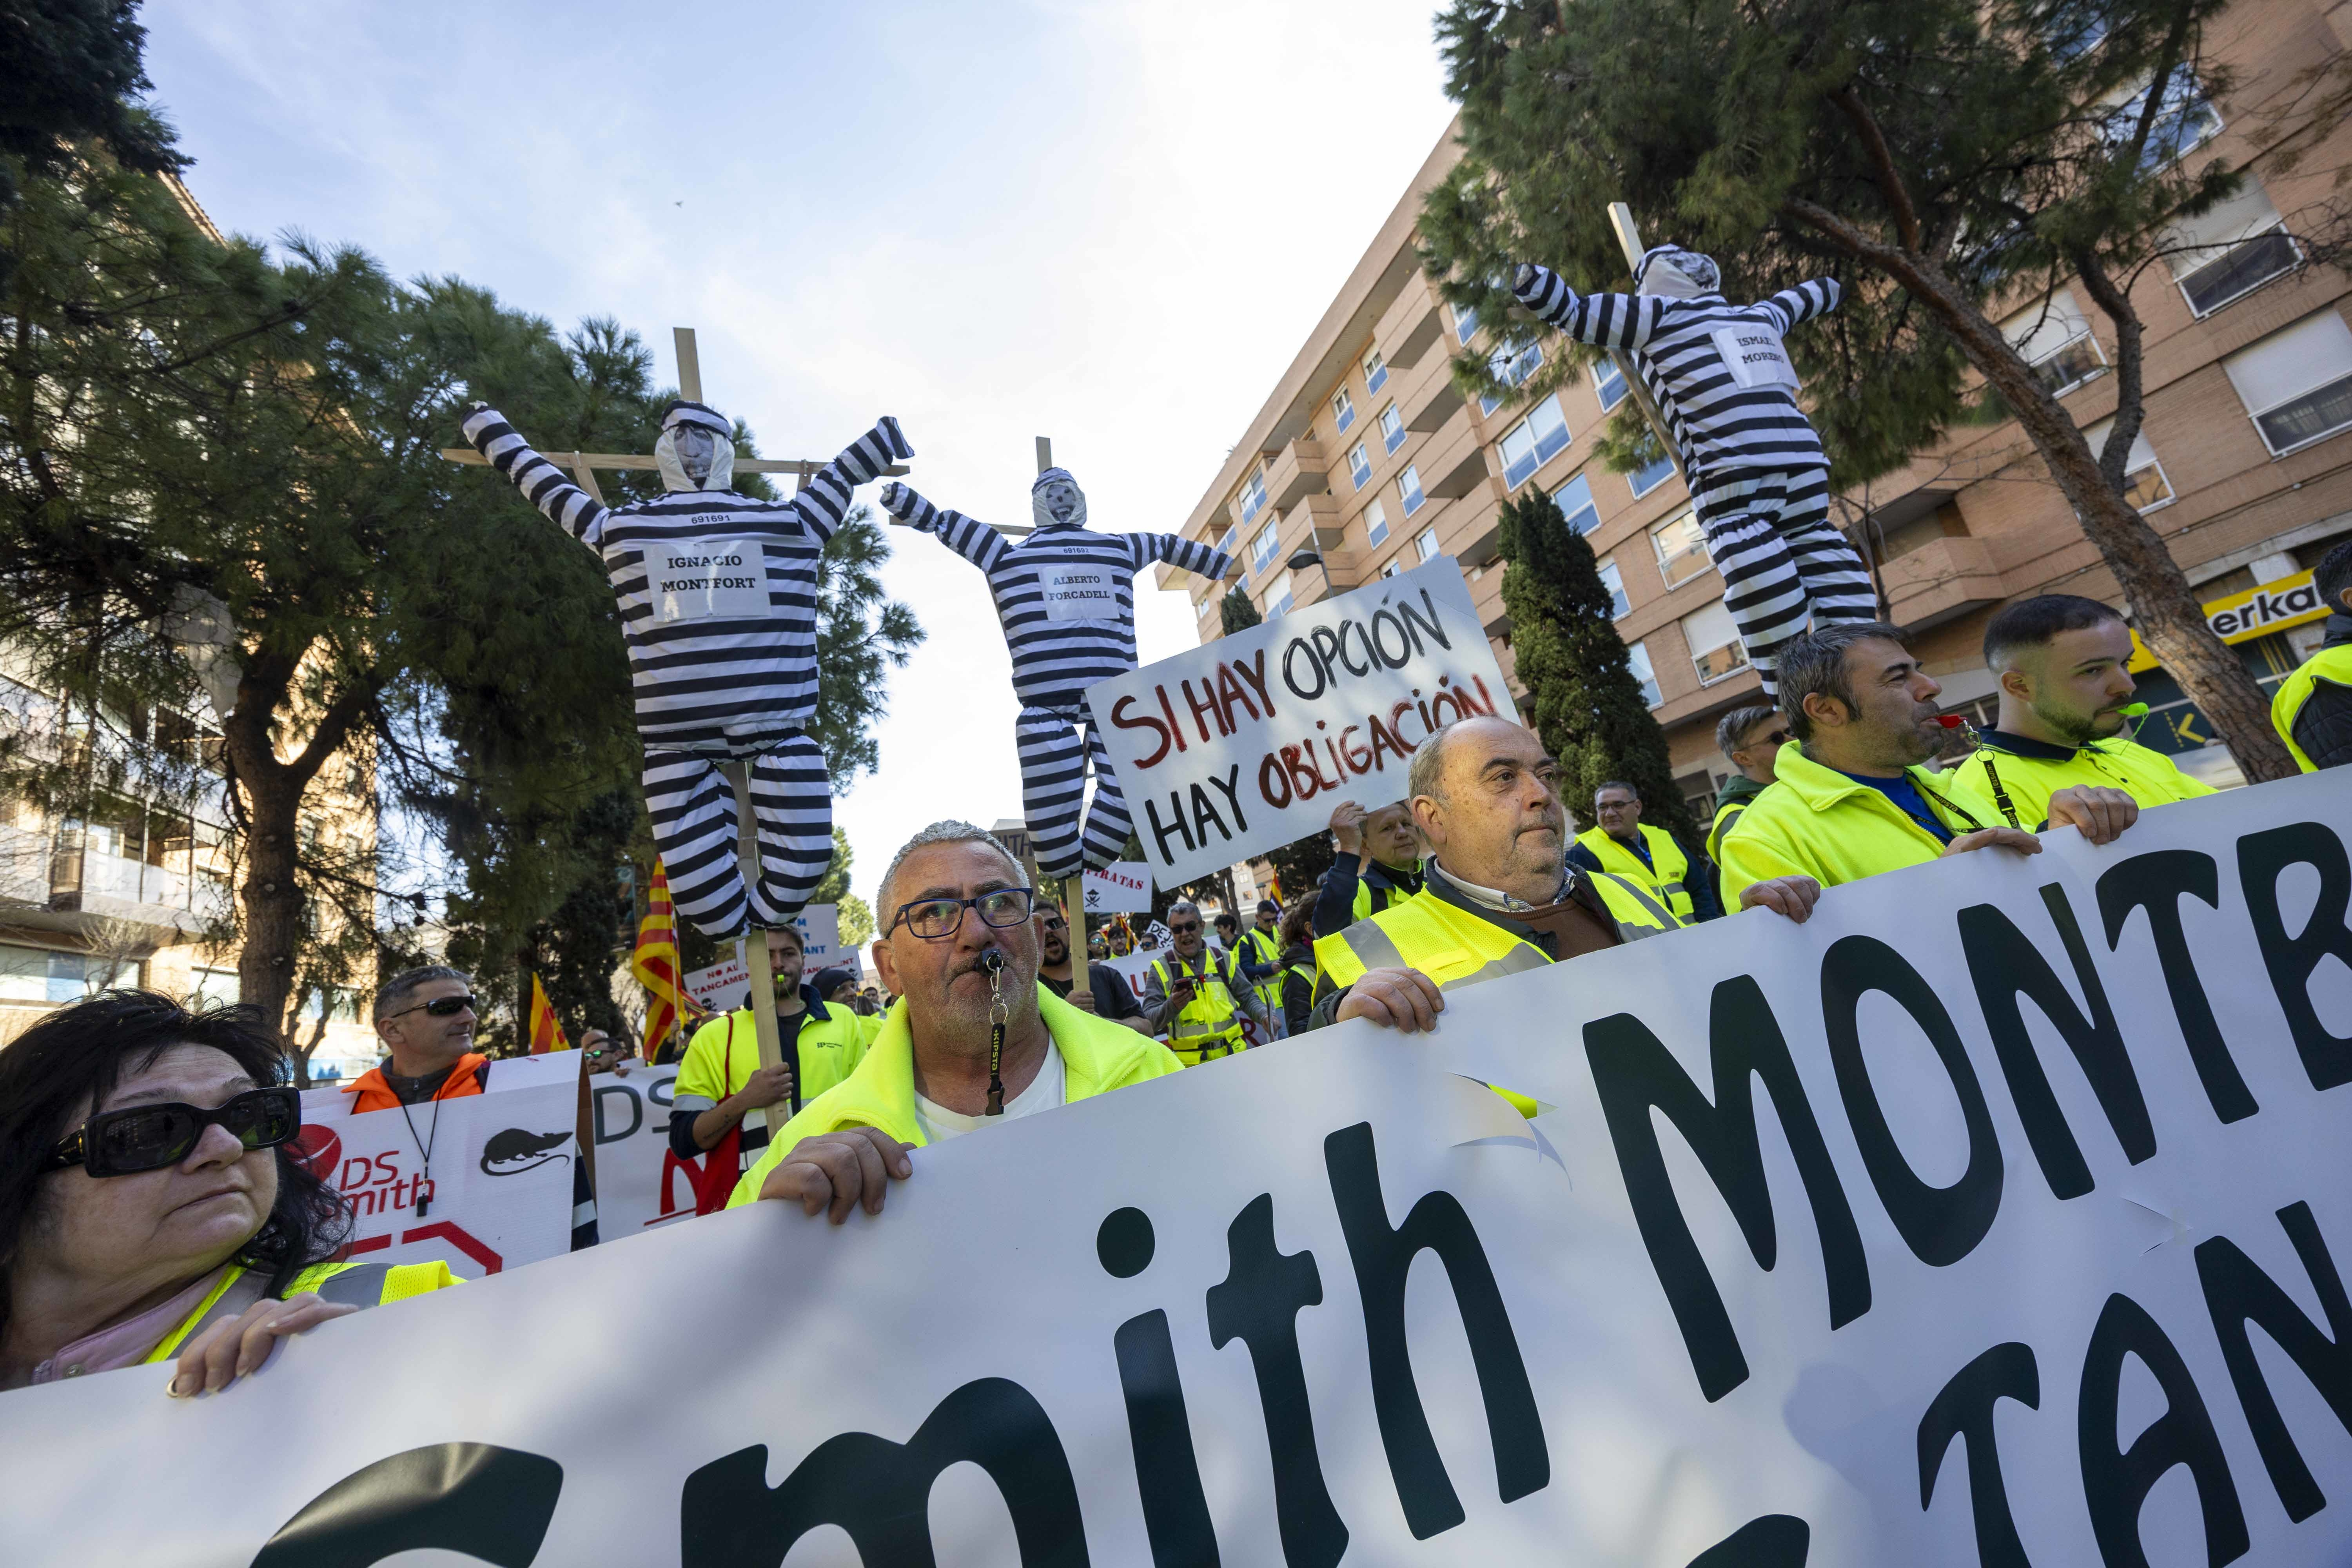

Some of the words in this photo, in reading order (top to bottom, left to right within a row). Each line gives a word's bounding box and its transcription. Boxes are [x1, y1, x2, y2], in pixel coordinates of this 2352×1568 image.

[1736, 336, 1775, 347] ISMAEL
[1741, 352, 1784, 364] MORENO
[691, 515, 731, 524] 691691
[667, 555, 742, 568] IGNACIO
[660, 577, 756, 593] MONTFORT
[1054, 575, 1100, 585] ALBERTO
[1048, 591, 1110, 601] FORCADELL
[1111, 684, 1187, 769] SI
[1180, 649, 1276, 743] HAY
[1282, 588, 1452, 701] OPCIÓN
[1145, 764, 1248, 866] HAY
[707, 969, 722, 979] NO
[339, 1150, 399, 1191] DS
[321, 1172, 436, 1222] mith
